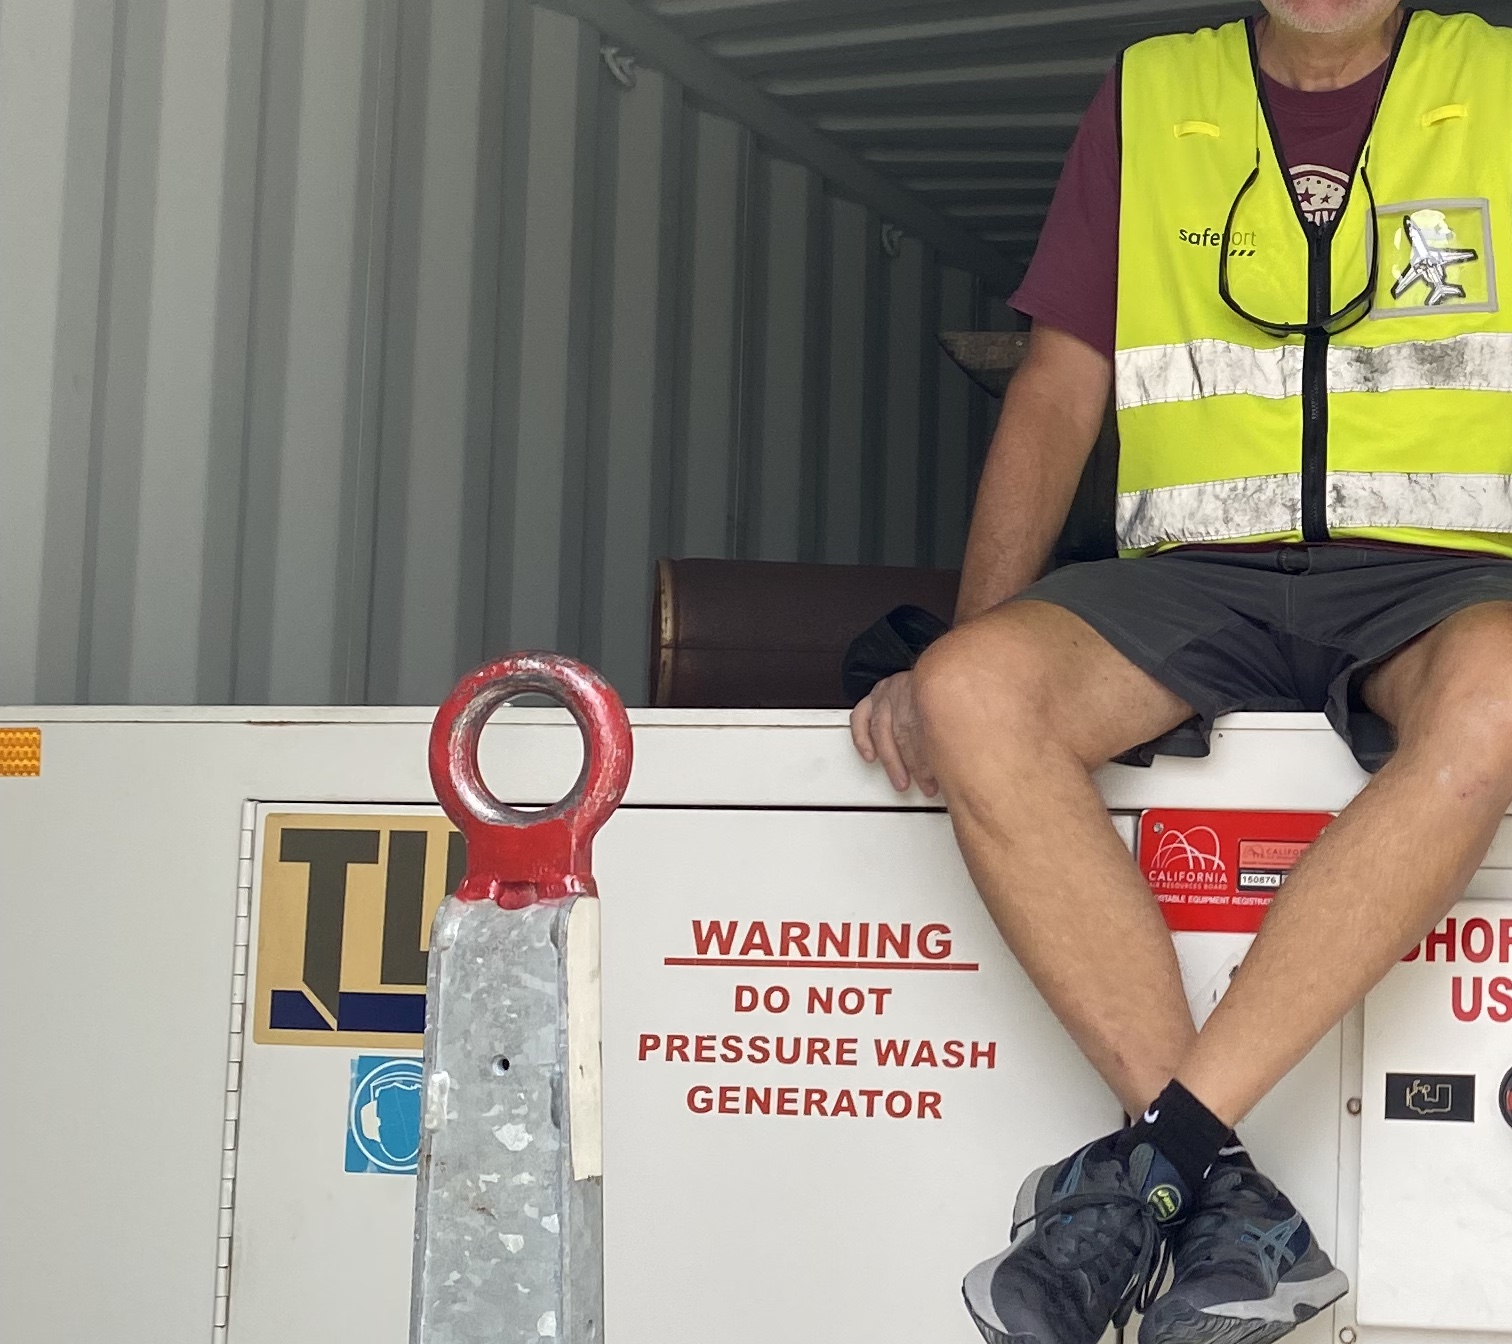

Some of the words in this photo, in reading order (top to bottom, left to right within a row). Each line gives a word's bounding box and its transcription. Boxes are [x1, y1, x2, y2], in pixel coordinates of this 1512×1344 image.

[1179, 227, 1257, 247] safeort
[1148, 870, 1228, 883] CALIFORNIA
[279, 827, 470, 1032] TL
[692, 919, 953, 960] WARNING
[734, 985, 791, 1014] DO
[806, 986, 893, 1015] NOT
[638, 1033, 859, 1067] PRESSURE
[874, 1038, 996, 1070] WASH
[686, 1085, 943, 1120] GENERATOR
